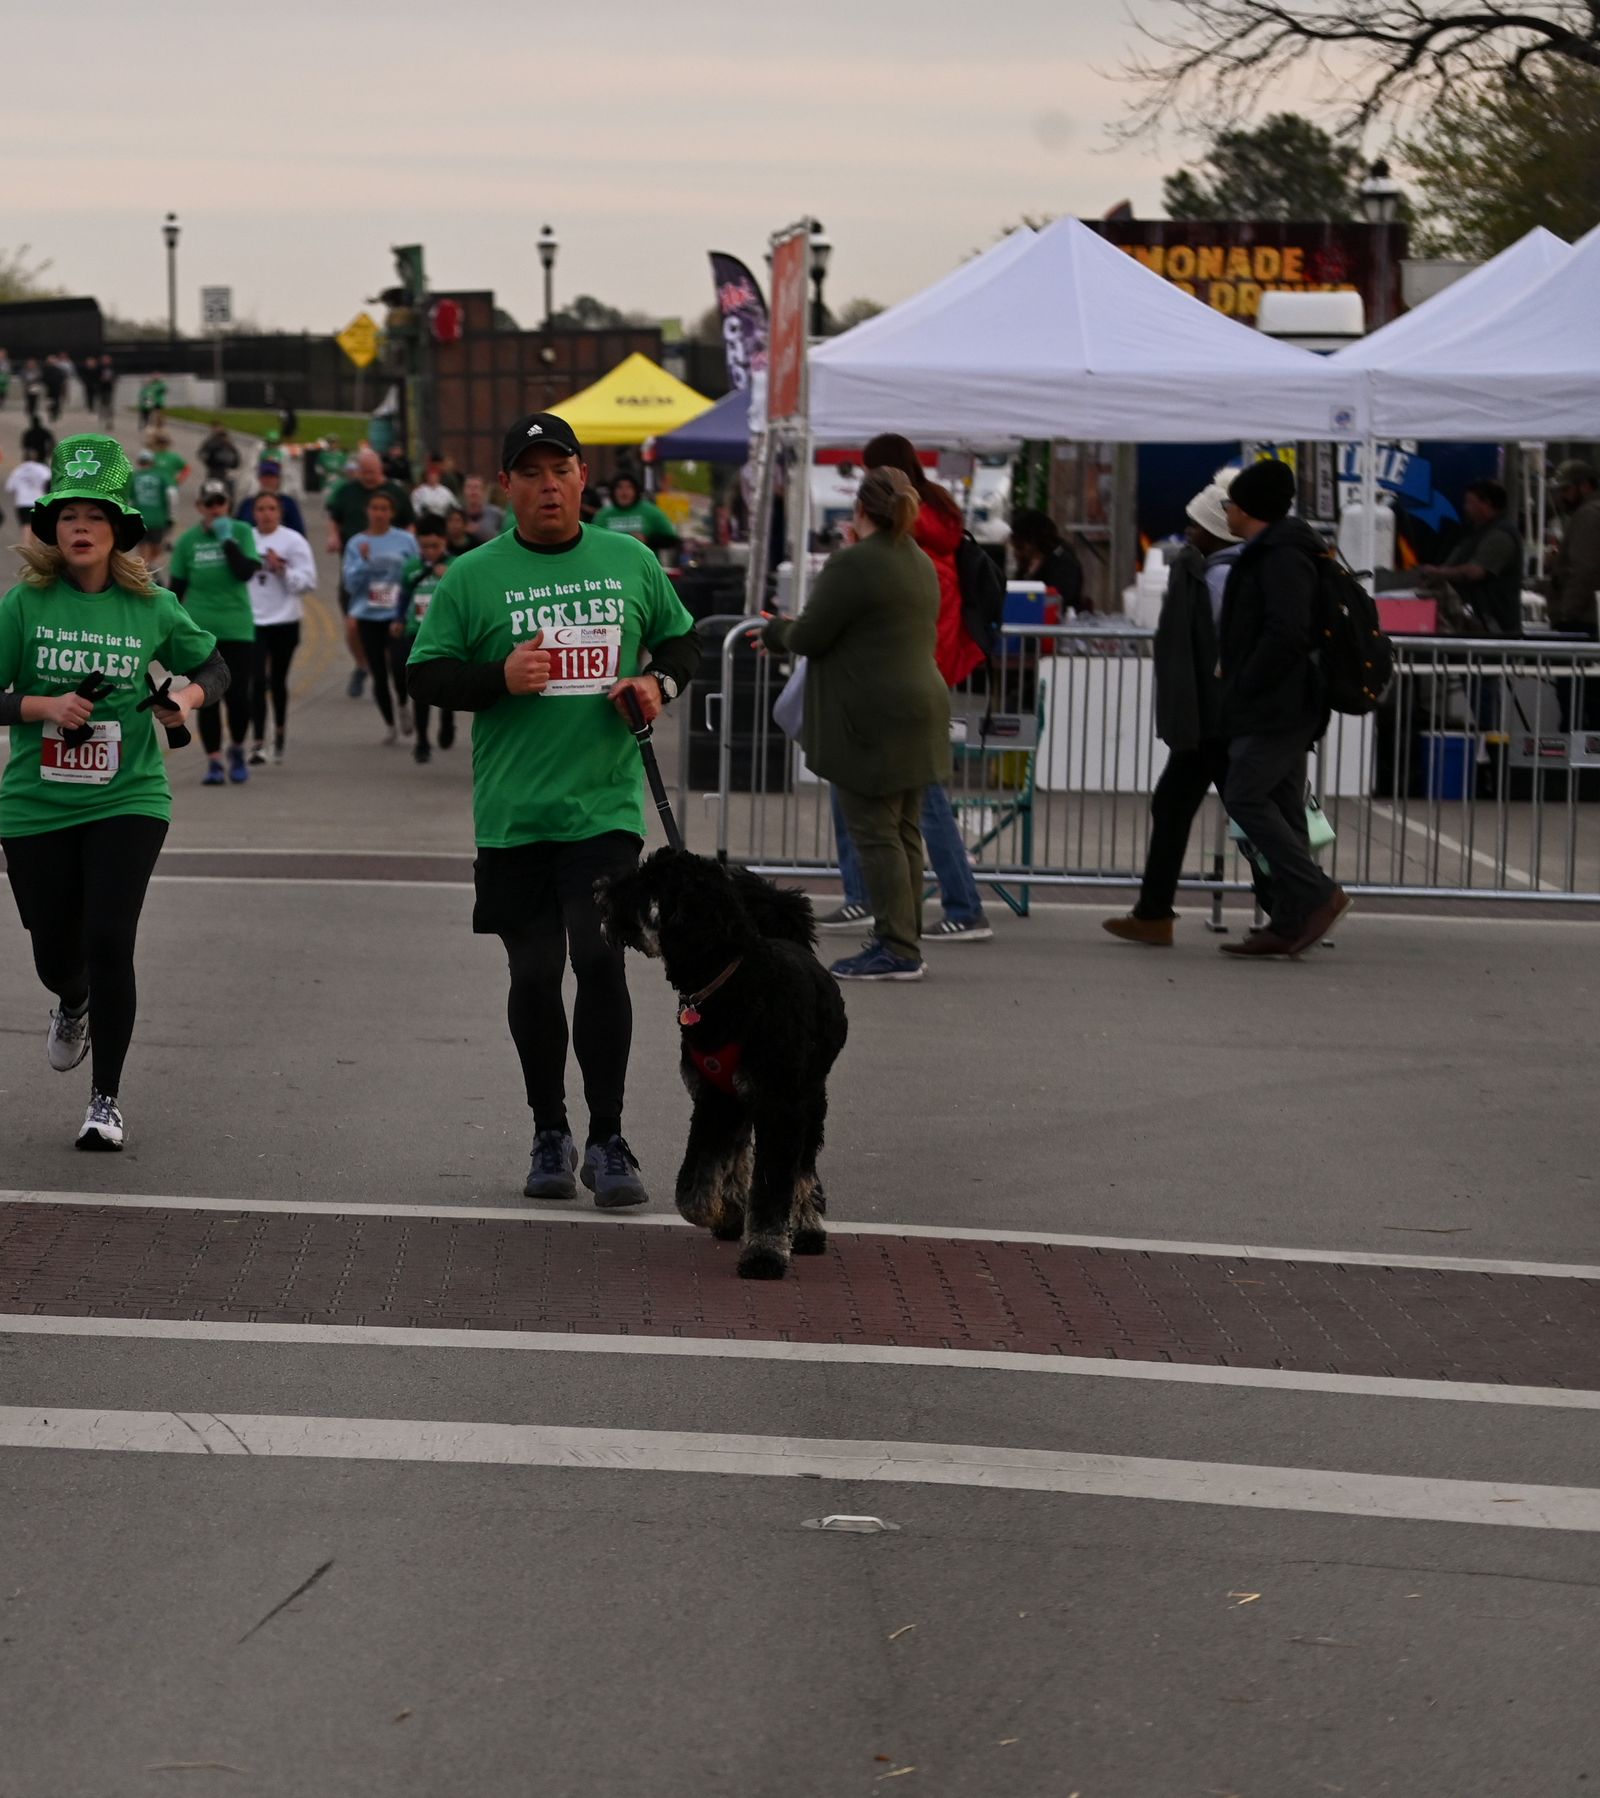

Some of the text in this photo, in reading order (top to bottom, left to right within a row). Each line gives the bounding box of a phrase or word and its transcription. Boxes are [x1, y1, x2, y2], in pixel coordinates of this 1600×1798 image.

[505, 578, 622, 604] I'm just here for the
[510, 598, 625, 636] PICKLES!
[36, 625, 142, 649] I'm just here for the
[36, 646, 140, 679] PICKLES!
[558, 648, 605, 679] 1113
[53, 742, 109, 769] 1406
